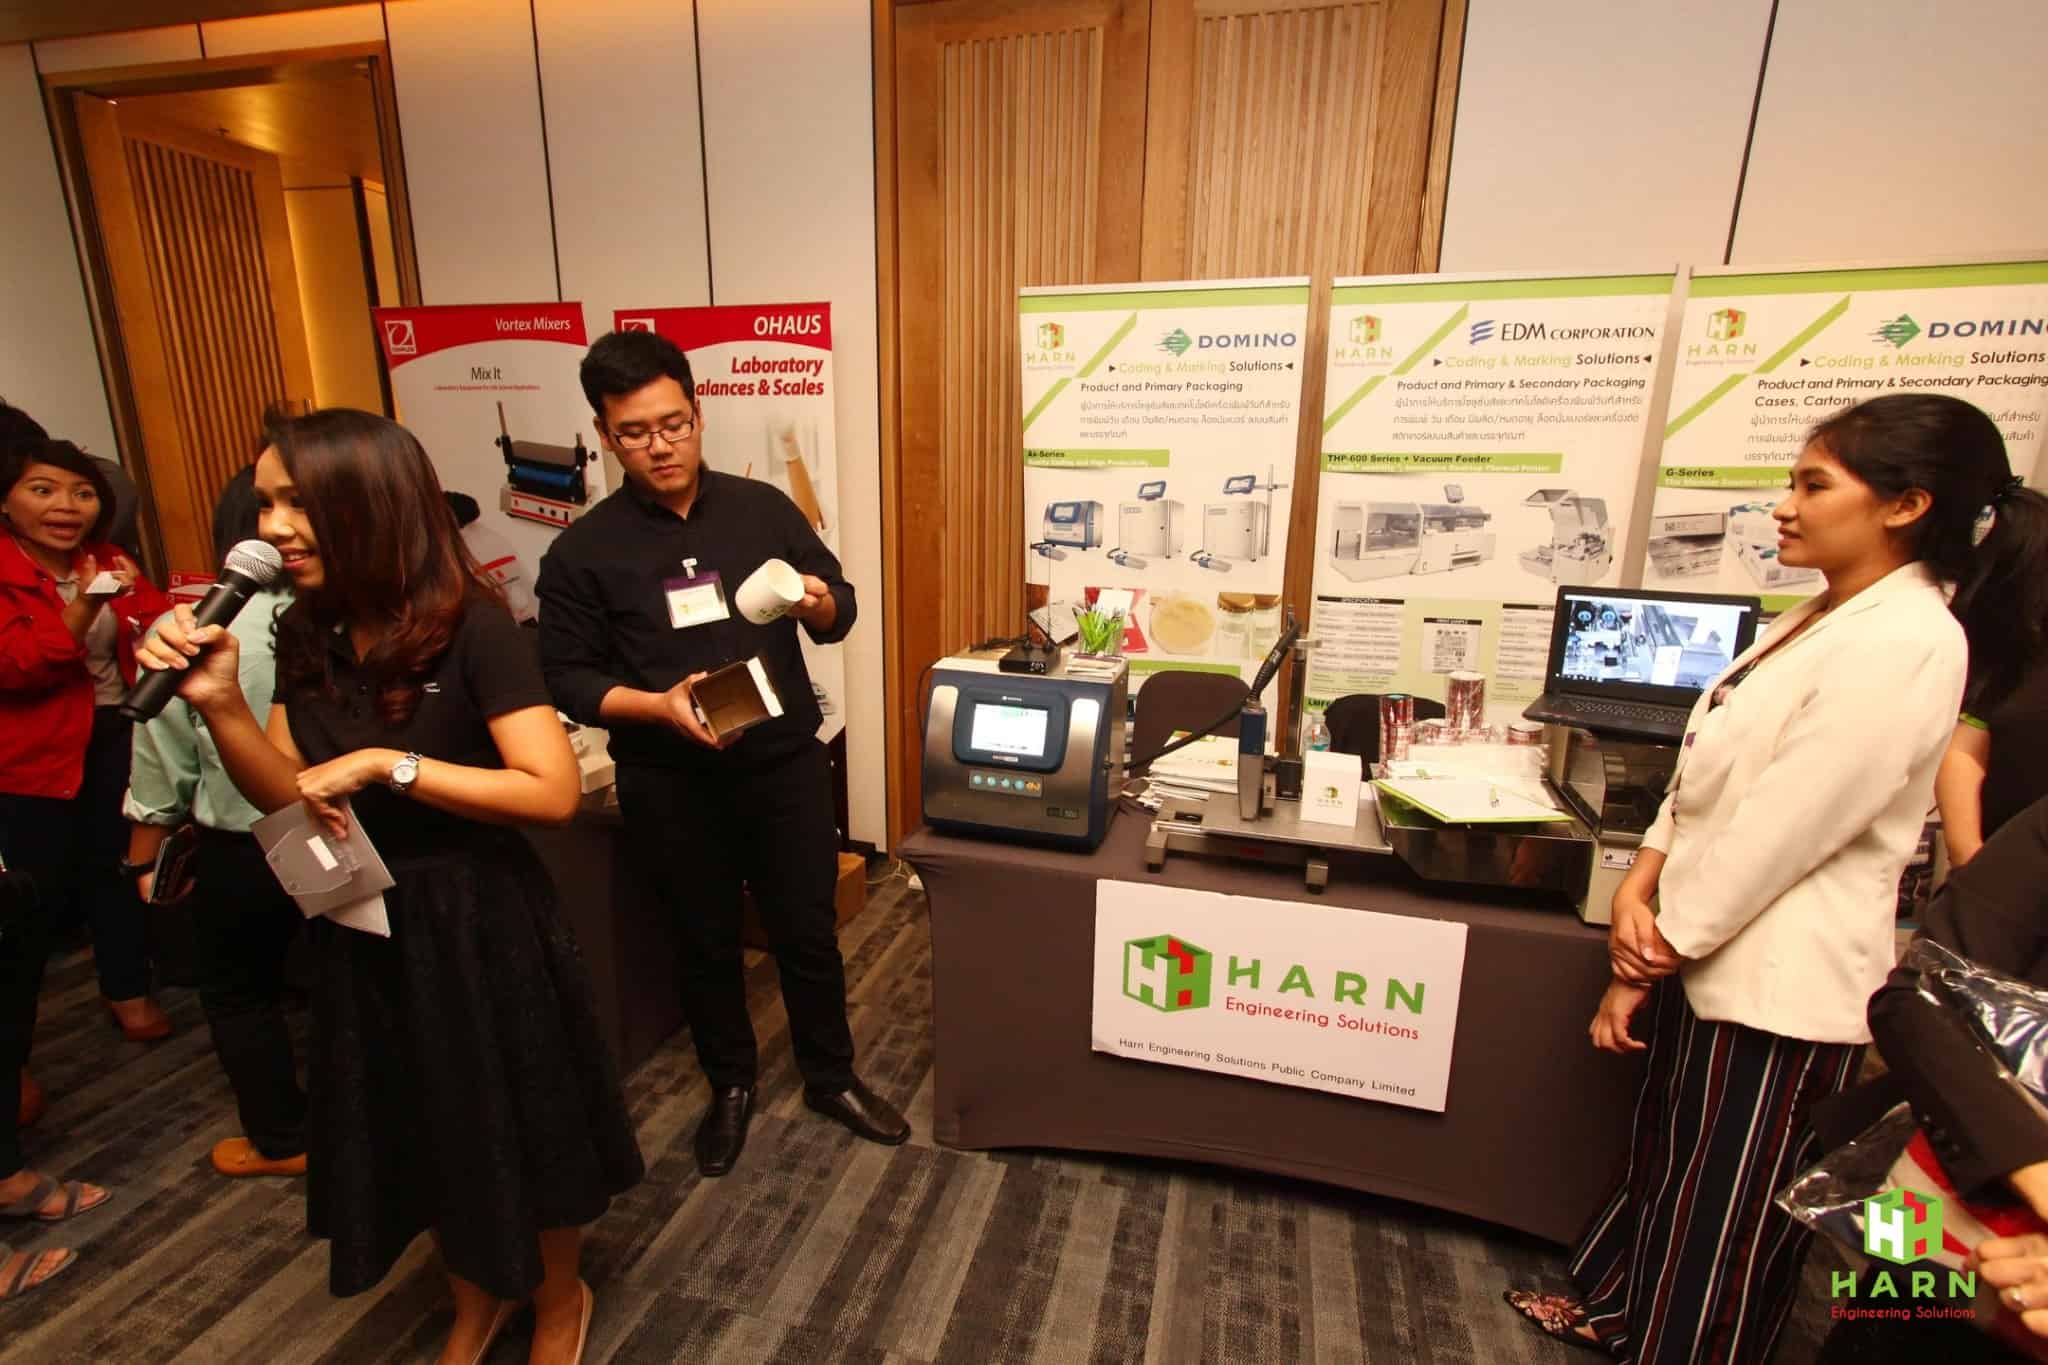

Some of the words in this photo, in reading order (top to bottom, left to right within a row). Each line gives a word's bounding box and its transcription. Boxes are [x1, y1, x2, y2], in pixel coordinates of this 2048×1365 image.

[495, 318, 531, 331] Vortex
[534, 317, 571, 330] Mixers
[753, 314, 822, 336] OHAUS
[1501, 323, 1547, 341] EDM
[1550, 326, 1656, 340] CORPORATION
[1928, 319, 2048, 338] DOMIN
[1198, 333, 1297, 349] DOMINO
[1687, 343, 1757, 356] HARN
[1335, 346, 1393, 360] HARN
[1445, 354, 1495, 369] Coding
[1501, 355, 1509, 367] &
[1514, 353, 1572, 368] Marking
[1575, 352, 1640, 366] Solutions
[1814, 355, 1874, 369] Coding
[1879, 355, 1889, 367] &
[1895, 352, 1965, 368] Marking
[1970, 350, 2046, 364] Solutions
[471, 367, 492, 381] Mix
[494, 367, 502, 380] It
[731, 357, 824, 377] Laboratory
[1229, 360, 1283, 372] Solutions
[696, 378, 755, 396] alances
[758, 380, 771, 396] &
[773, 378, 824, 396] Scales
[1081, 383, 1119, 393] Product
[1122, 383, 1142, 392] and
[1145, 382, 1183, 394] Primary
[1186, 381, 1243, 393] Packaging
[1397, 380, 1438, 391] Product
[1441, 380, 1462, 390] and
[1465, 378, 1505, 392] Primary
[1508, 379, 1516, 388] &
[1519, 378, 1579, 390] Secondary
[1583, 376, 1646, 390] Packaging
[1757, 378, 1805, 390] Product
[1807, 377, 1833, 389] and
[1836, 376, 1884, 391] Primary
[1887, 376, 1896, 388] &
[1899, 375, 1974, 389] Secondary
[1977, 373, 2048, 388] Packaging
[1370, 454, 1401, 463] Series
[1412, 455, 1452, 463] Vacuum
[1455, 455, 1491, 463] Feeder
[1666, 468, 1715, 477] G-Series
[1227, 955, 1425, 1015] HARN
[1226, 996, 1329, 1027] Engineering
[1337, 1014, 1419, 1040] Solutions
[1119, 1037, 1144, 1049] Harn
[1148, 1042, 1211, 1062] Engineering
[1216, 1054, 1267, 1070] Solutions
[1271, 1063, 1305, 1077] Public
[1311, 1070, 1365, 1089] Company
[1372, 1080, 1416, 1097] Limited
